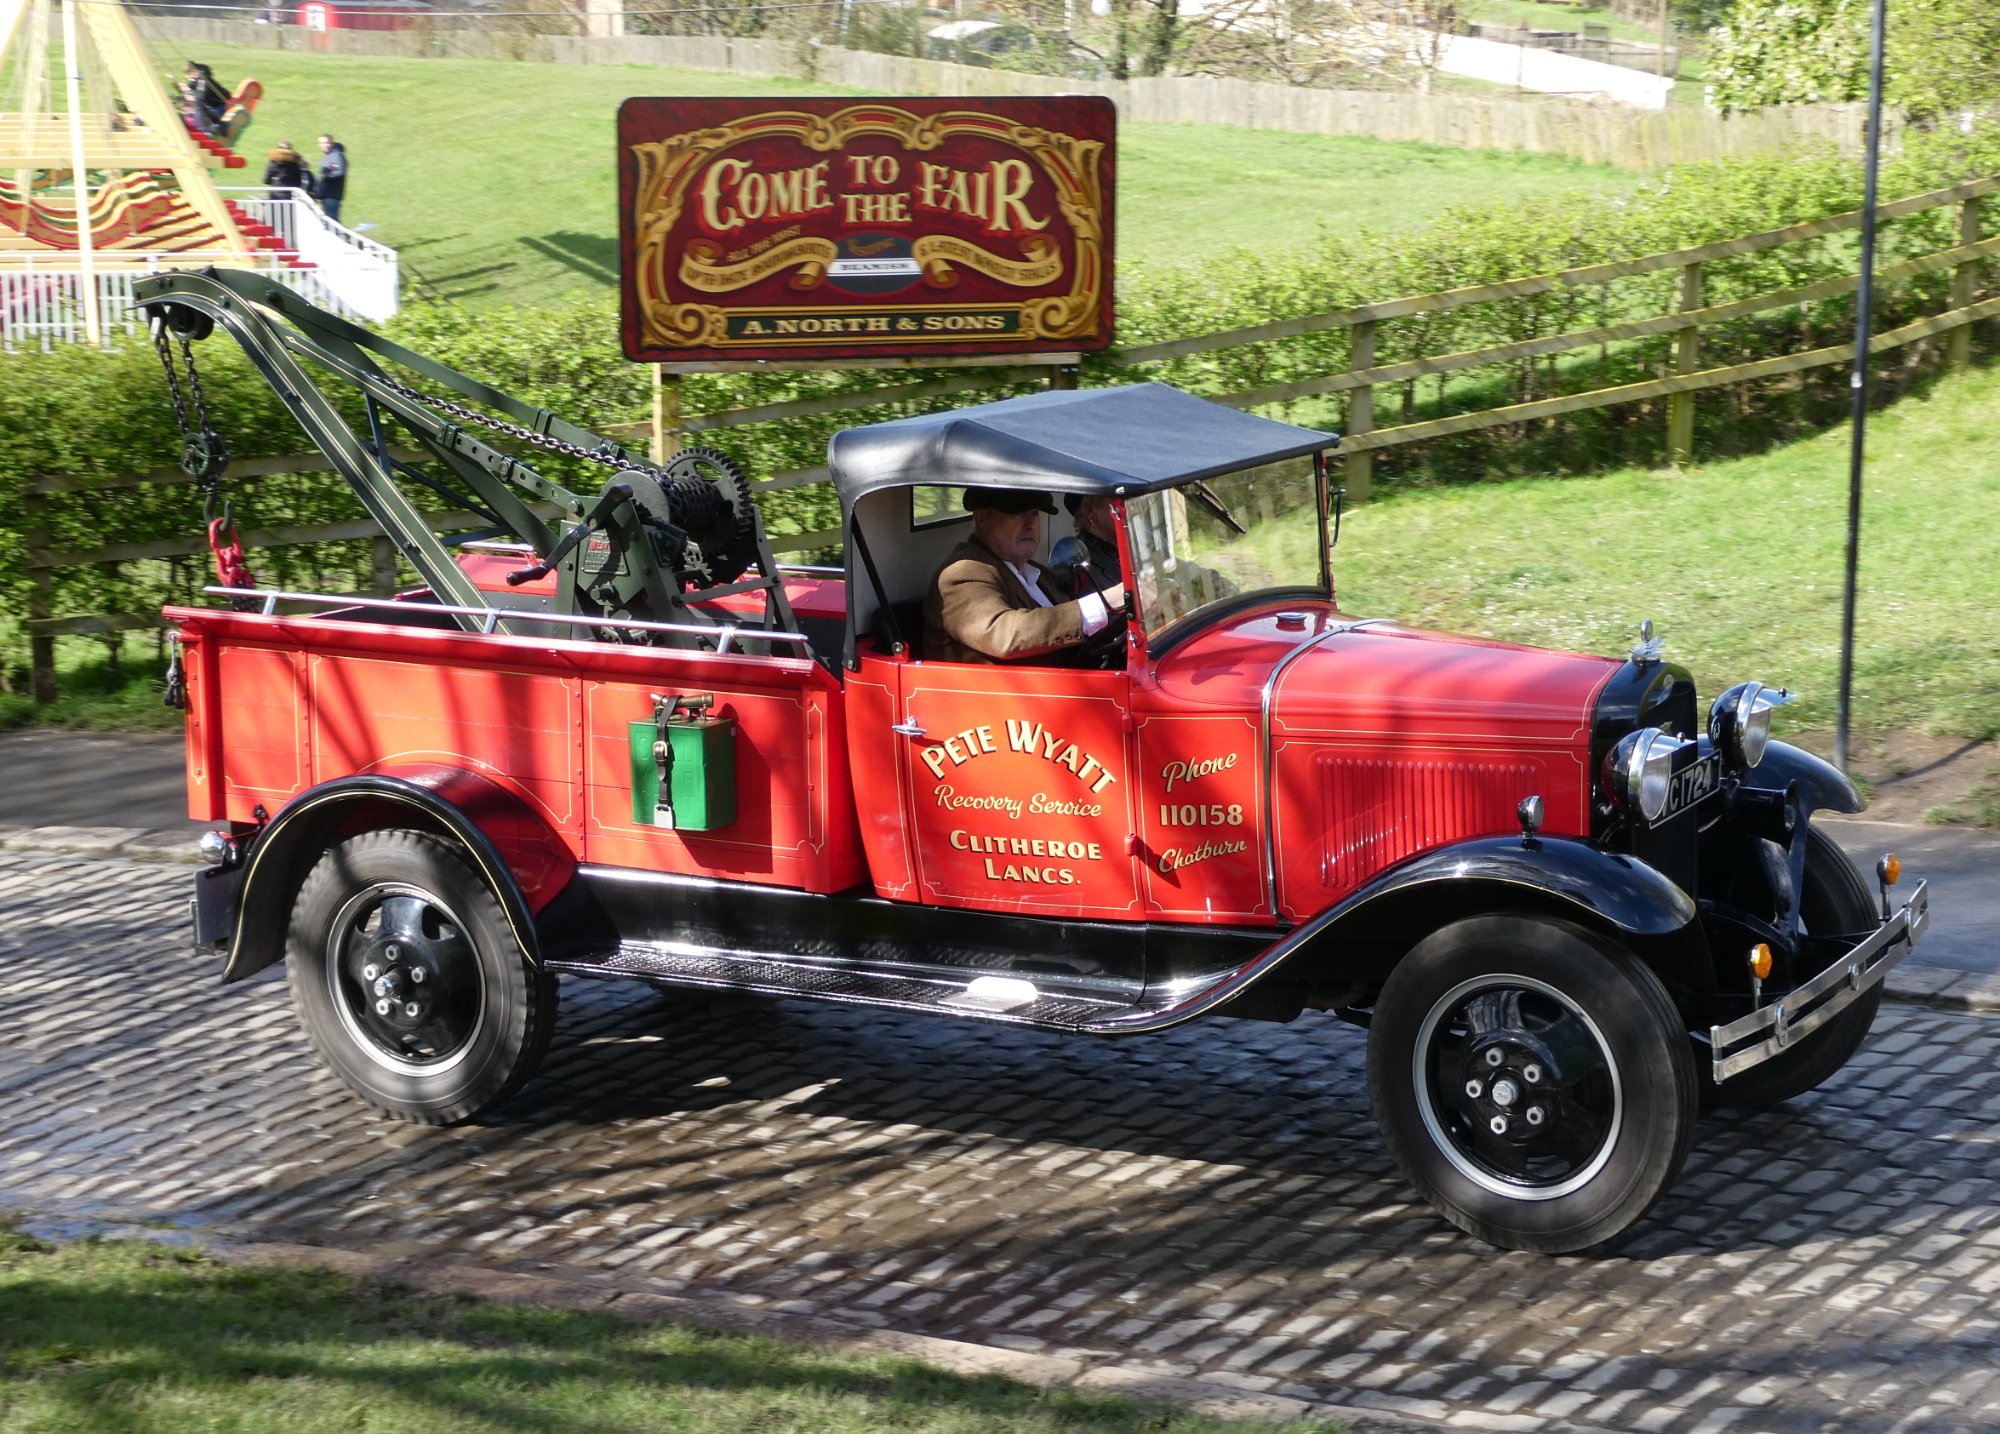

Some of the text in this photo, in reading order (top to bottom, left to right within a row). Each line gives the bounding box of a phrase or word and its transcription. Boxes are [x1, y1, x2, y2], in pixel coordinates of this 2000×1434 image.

[700, 155, 1051, 231] COME TO THE FAIR
[896, 317, 919, 331] &
[923, 315, 1006, 331] SONS
[920, 718, 1118, 795] PETE WYATT
[1161, 752, 1237, 793] Phone
[933, 784, 1102, 820] Recovery Service
[1160, 804, 1244, 827] 110158
[949, 830, 1103, 861] CLITHEROE
[1158, 838, 1247, 875] Chatburn
[984, 857, 1083, 886] LANCS.
